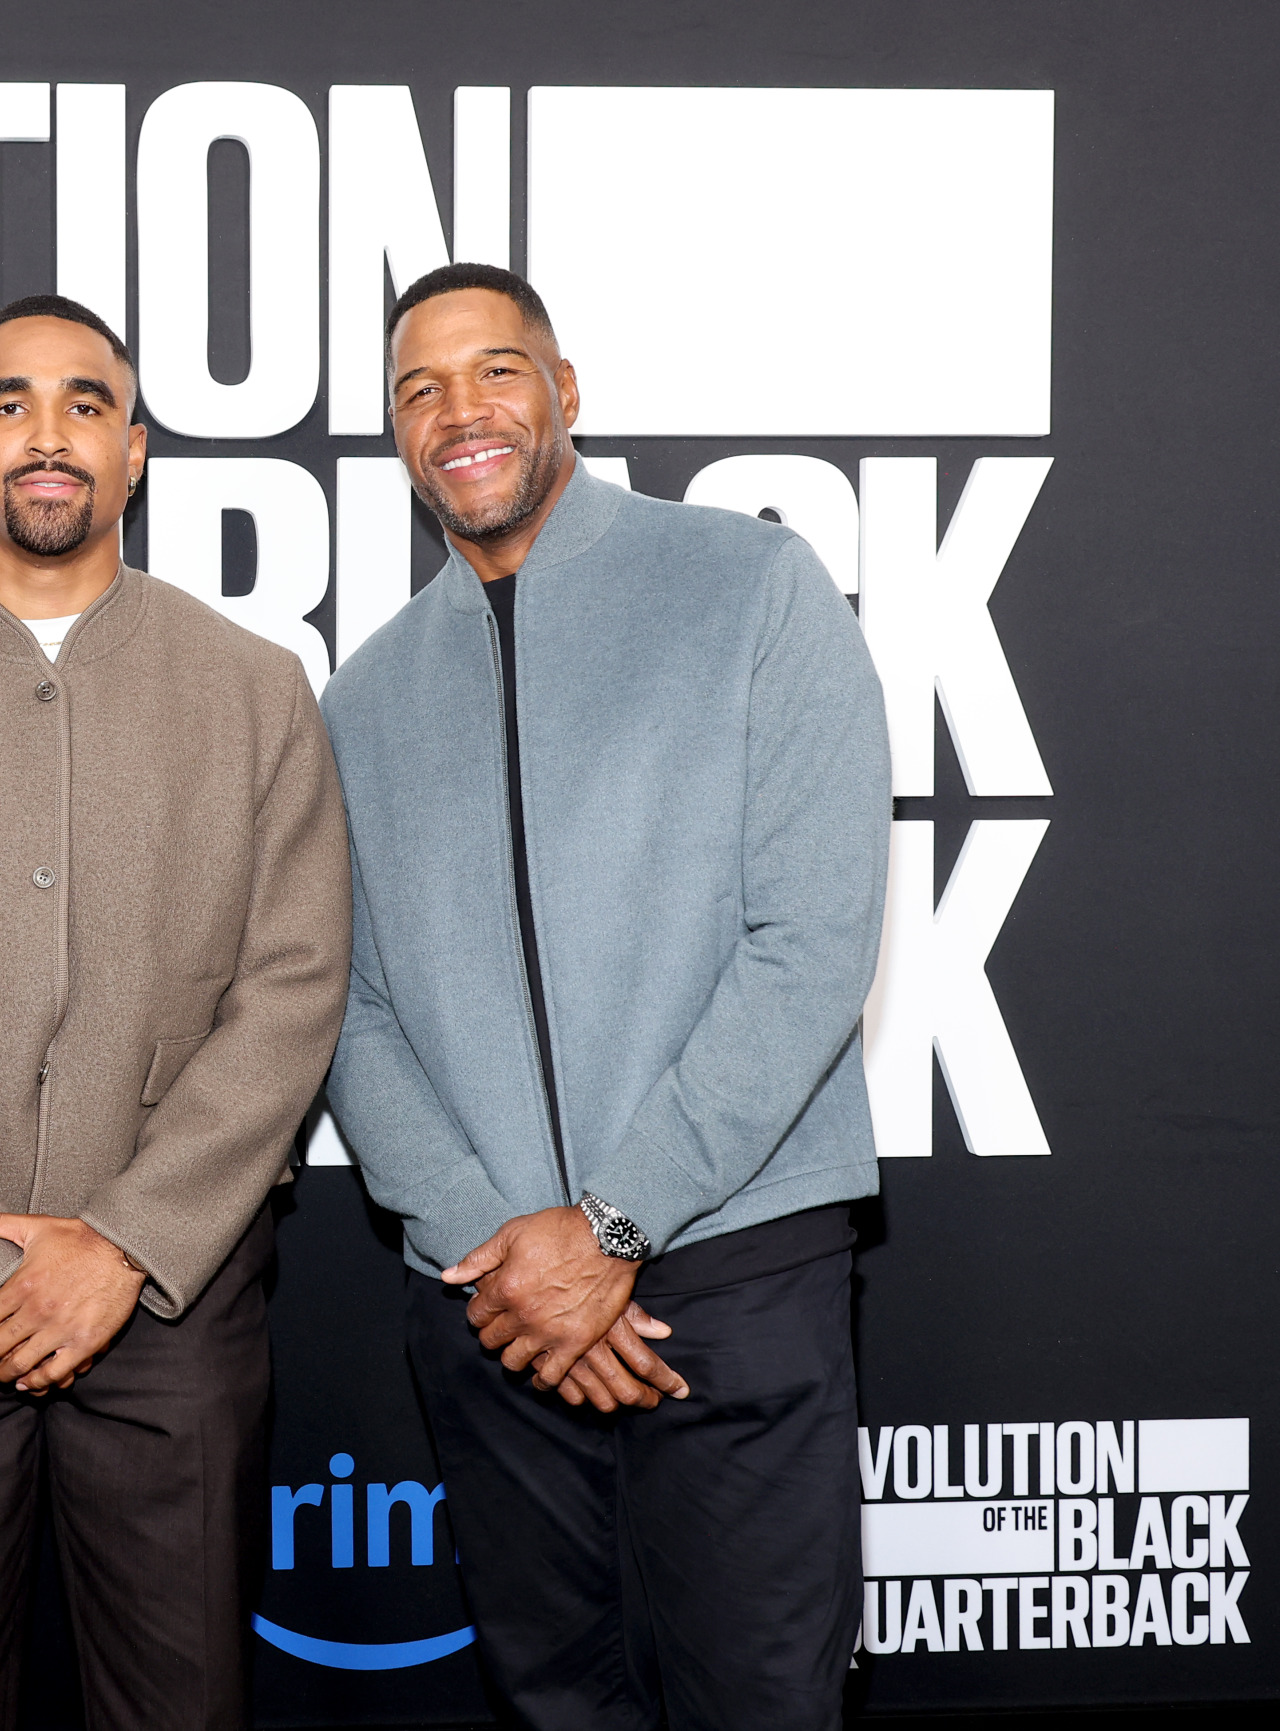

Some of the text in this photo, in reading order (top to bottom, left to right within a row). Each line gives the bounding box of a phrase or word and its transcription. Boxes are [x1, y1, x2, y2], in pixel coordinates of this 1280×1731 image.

[857, 1420, 1135, 1500] VOLUTION
[271, 1452, 460, 1570] rim
[982, 1506, 1048, 1532] OF THE
[1058, 1494, 1252, 1571] BLACK
[853, 1571, 1252, 1656] UARTERBACK
